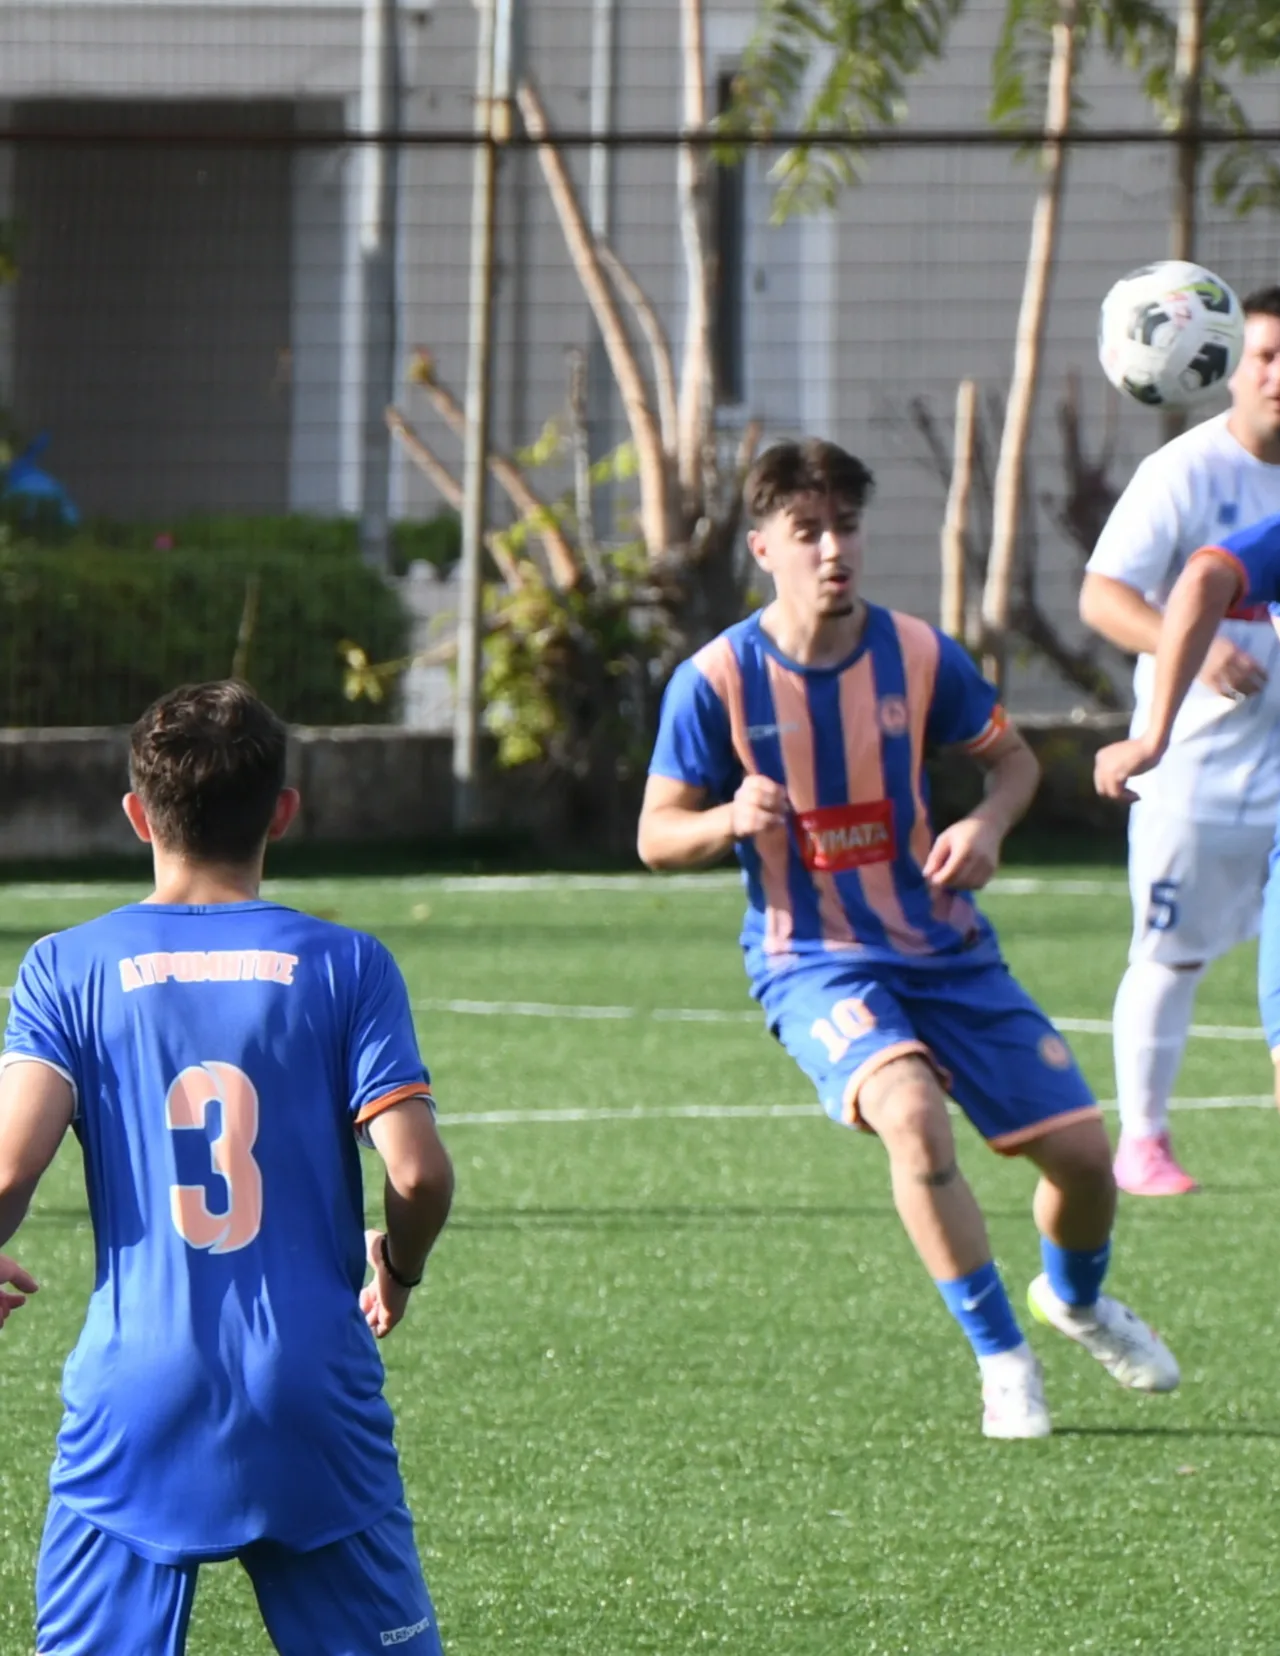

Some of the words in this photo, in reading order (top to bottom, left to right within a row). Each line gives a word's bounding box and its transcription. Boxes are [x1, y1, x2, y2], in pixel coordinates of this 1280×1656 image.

[1149, 881, 1182, 931] 5
[118, 950, 299, 993] ΑΤΡΟΜΗΤΟΣ
[810, 997, 876, 1064] 10
[165, 1060, 263, 1255] 3
